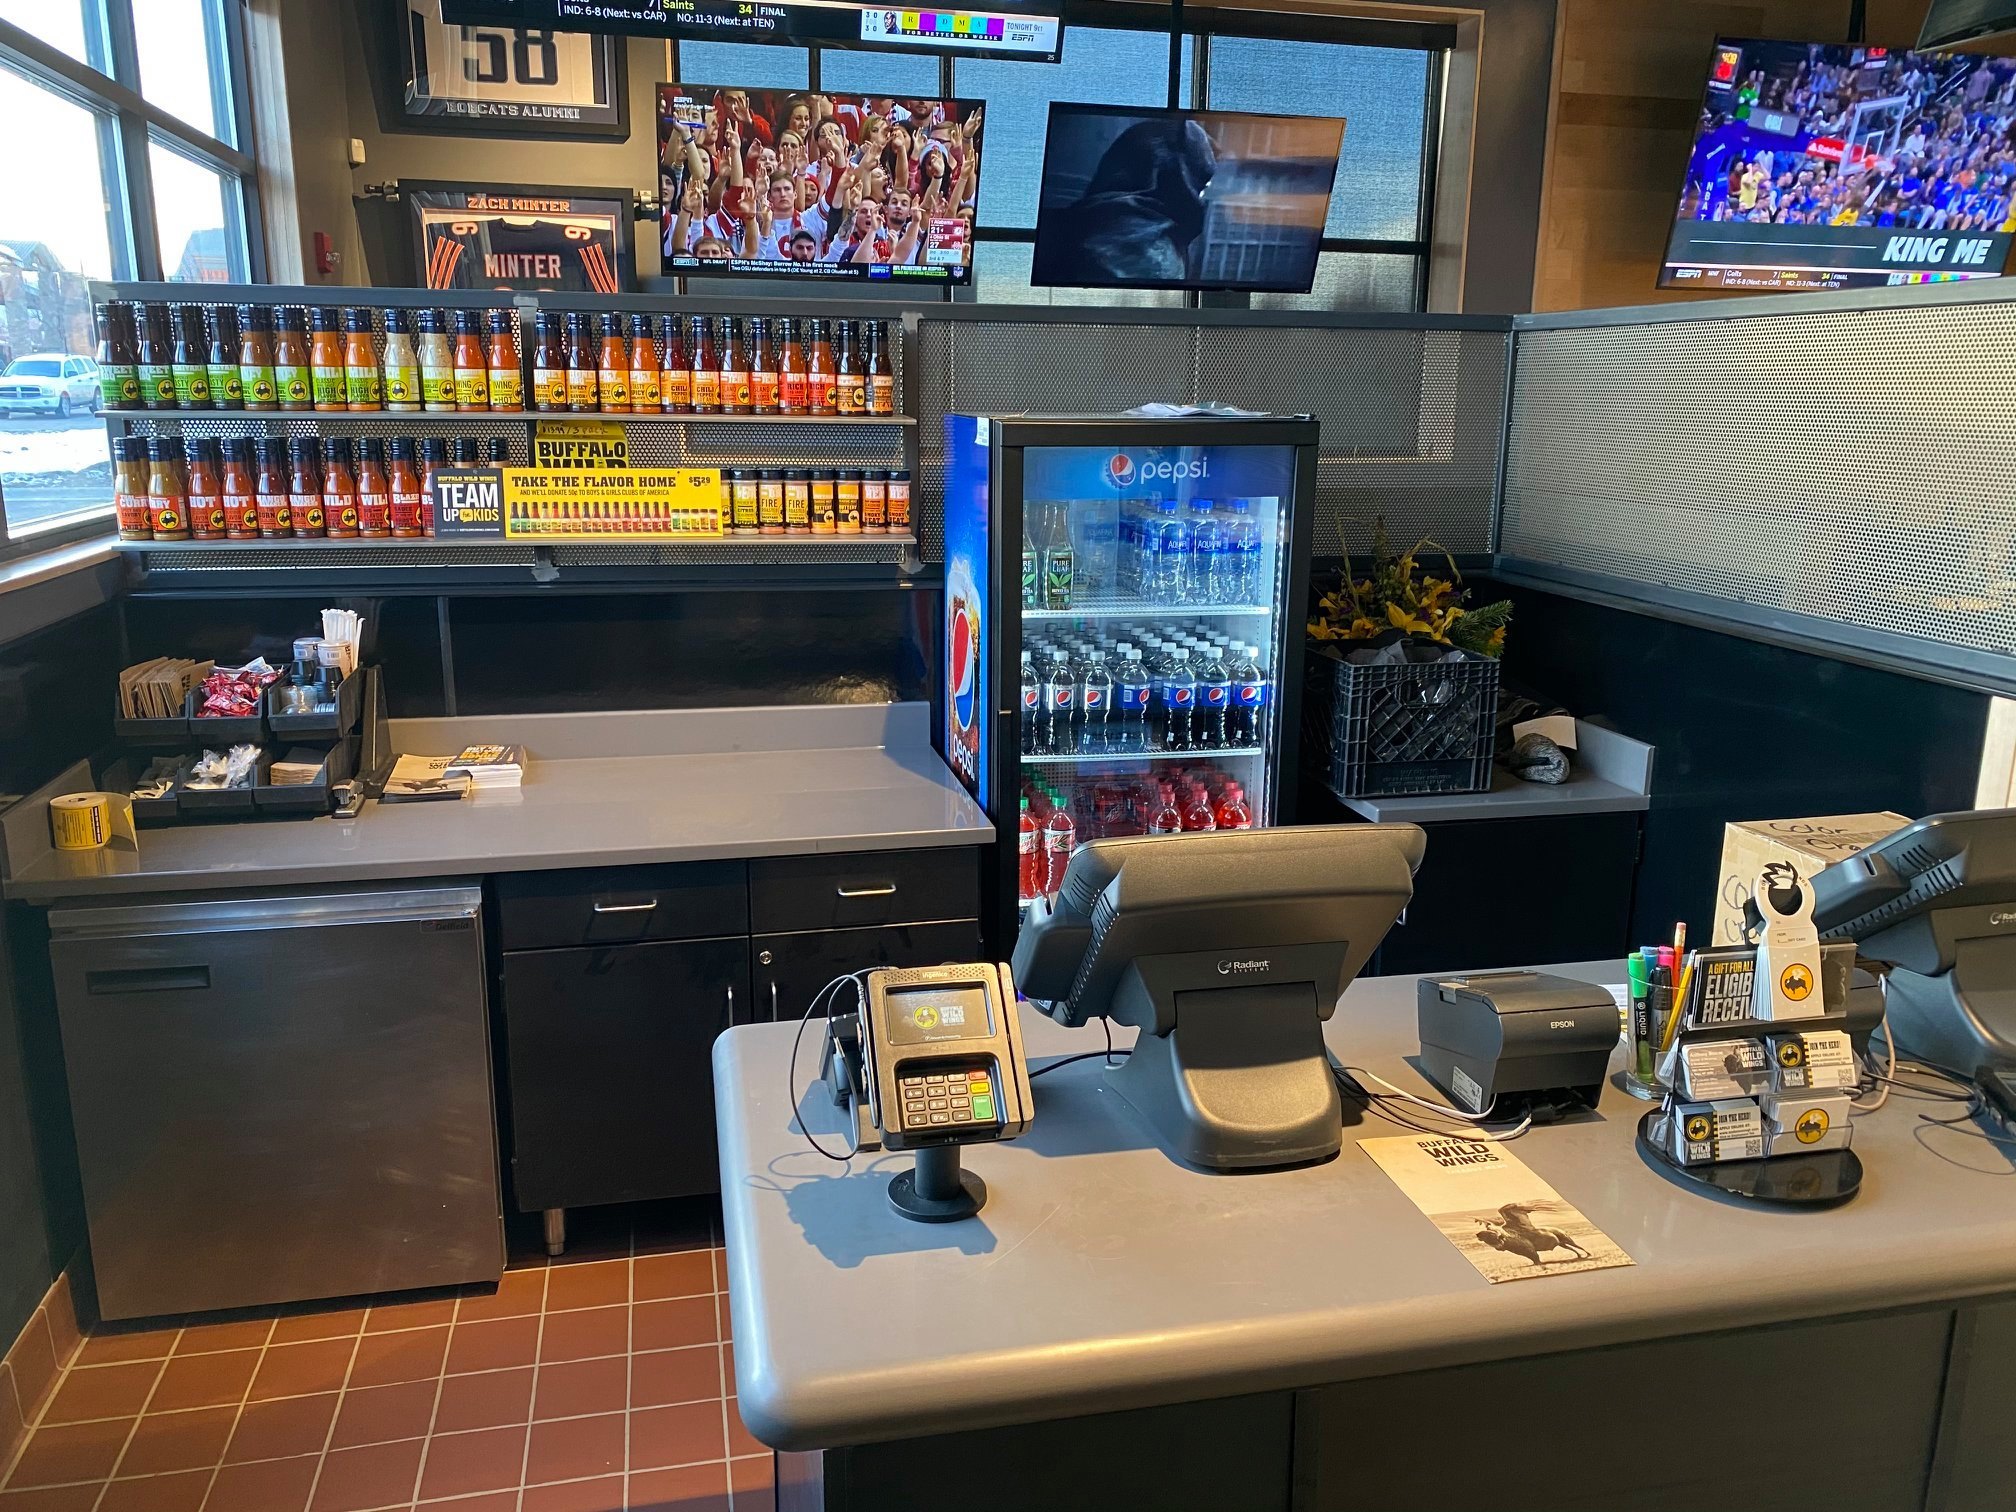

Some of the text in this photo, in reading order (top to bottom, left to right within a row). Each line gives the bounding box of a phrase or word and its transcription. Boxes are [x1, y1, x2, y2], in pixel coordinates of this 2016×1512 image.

[663, 0, 787, 17] Saints 34 FINAL
[564, 5, 775, 29] IND: 6-8 (Next: vs CAR) NO: 11-3 (Next: at TEN)
[1007, 22, 1033, 32] TONIGHT
[1012, 34, 1034, 42] ESPN
[446, 101, 580, 120] BOBCATS ALUMNI
[467, 197, 570, 212] ZACH MINTER
[930, 226, 939, 234] 21
[1883, 236, 1993, 264] KING ME
[485, 253, 562, 279] MINTER
[1676, 269, 1703, 278] ESPN
[1781, 271, 1799, 279] Saints
[537, 441, 626, 458] BUFFALO
[1140, 456, 1208, 485] pepsi
[511, 476, 548, 488] TAKE
[551, 476, 580, 488] THE
[583, 476, 635, 488] FLAVOR
[638, 476, 676, 488] HOME
[323, 494, 352, 506] WILD
[437, 483, 499, 508] TEAM
[761, 498, 778, 508] FIRE
[788, 499, 805, 509] FIRE
[442, 508, 459, 522] UP
[473, 508, 499, 522] KIDS
[953, 733, 974, 779] pepsi
[1233, 960, 1269, 969] Radiant
[1708, 960, 1754, 975] A GIFT FOR ALL
[1705, 972, 1754, 999] ELIGIB
[1550, 1020, 1575, 1029] EPSON
[1638, 1011, 1647, 1036] LIQUID
[1809, 1042, 1819, 1050] JOIN
[1818, 1041, 1828, 1050] THE
[1741, 1052, 1763, 1061] WILD
[1742, 1059, 1764, 1068] WINGS
[1728, 1113, 1738, 1121] THE
[1422, 1143, 1490, 1158] WILD
[1689, 1145, 1711, 1154] WILD
[1434, 1154, 1500, 1167] WINGS
